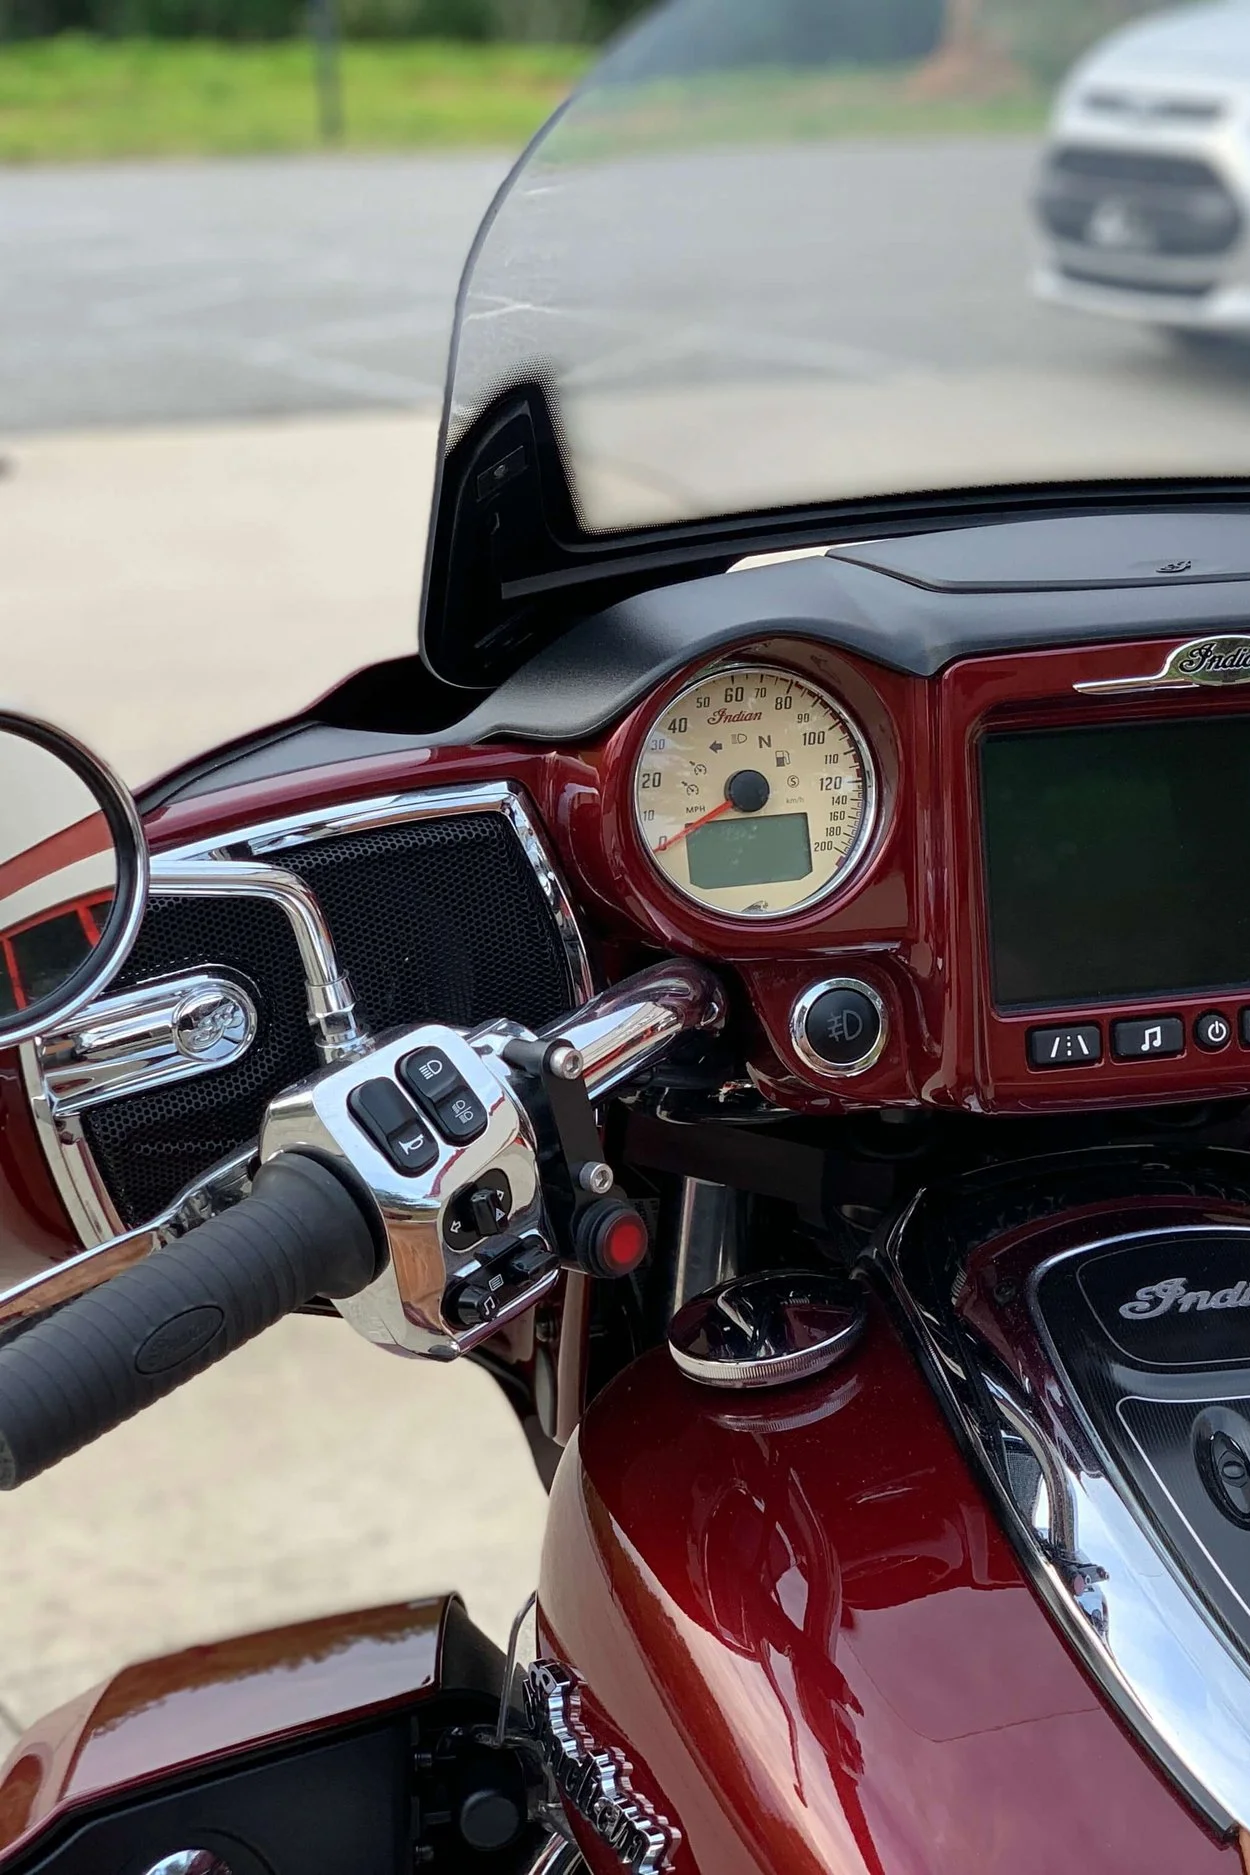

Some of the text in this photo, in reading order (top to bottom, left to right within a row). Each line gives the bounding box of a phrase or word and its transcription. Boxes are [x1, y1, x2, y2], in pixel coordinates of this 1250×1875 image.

[724, 686, 745, 703] 60
[754, 687, 767, 698] 70
[696, 696, 710, 708] 50
[774, 695, 793, 710] 80
[707, 708, 762, 725] Indian
[797, 713, 810, 724] 90
[667, 717, 688, 734] 40
[651, 739, 665, 750] 30
[758, 735, 772, 749] N
[802, 731, 826, 746] 100
[824, 753, 839, 765] 110
[641, 772, 661, 789] 20
[819, 776, 842, 791] 120
[831, 795, 848, 806] 140
[685, 805, 706, 814] MPH
[643, 810, 655, 822] 10
[829, 810, 846, 822] 160
[825, 826, 842, 837] 180
[658, 835, 668, 851] 0
[814, 841, 833, 852] 200
